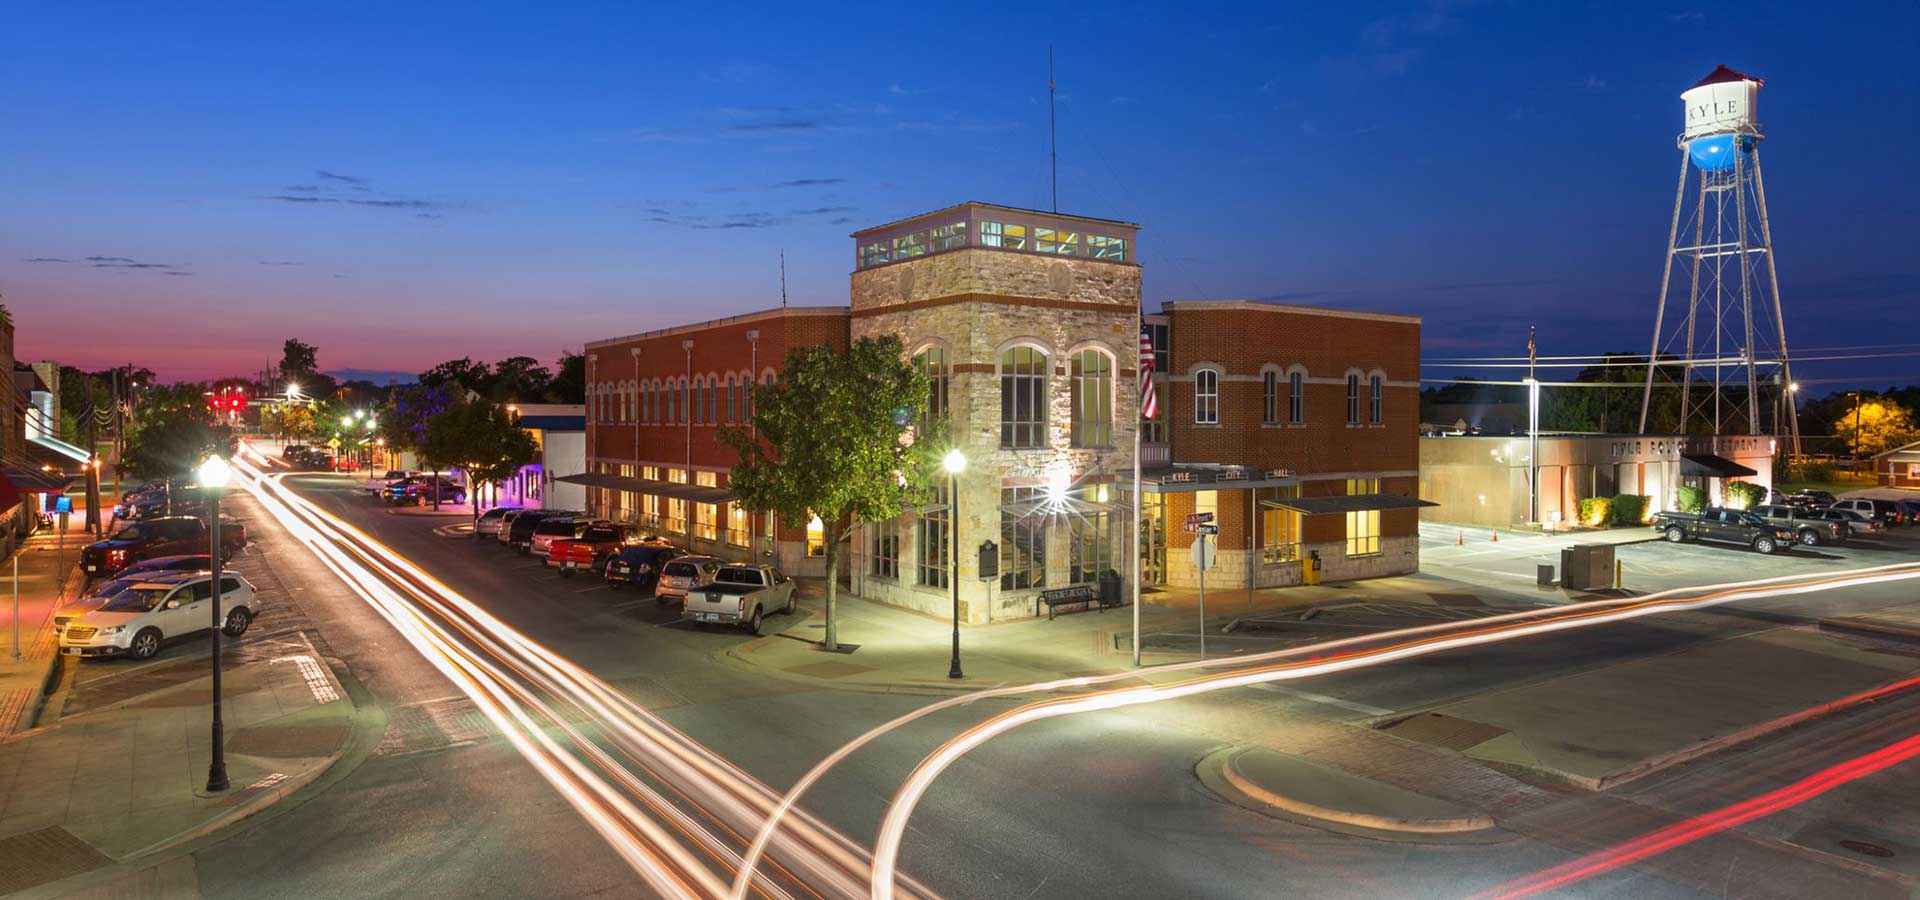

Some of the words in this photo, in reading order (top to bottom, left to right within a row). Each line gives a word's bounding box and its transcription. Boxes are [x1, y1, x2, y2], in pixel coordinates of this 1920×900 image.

[1689, 100, 1737, 120] KYLE
[1611, 441, 1641, 456] KYLE
[1697, 438, 1758, 454] DEPRTMENT
[1172, 472, 1190, 482] KYLE
[1225, 470, 1241, 480] CITY
[1273, 468, 1289, 478] HALL
